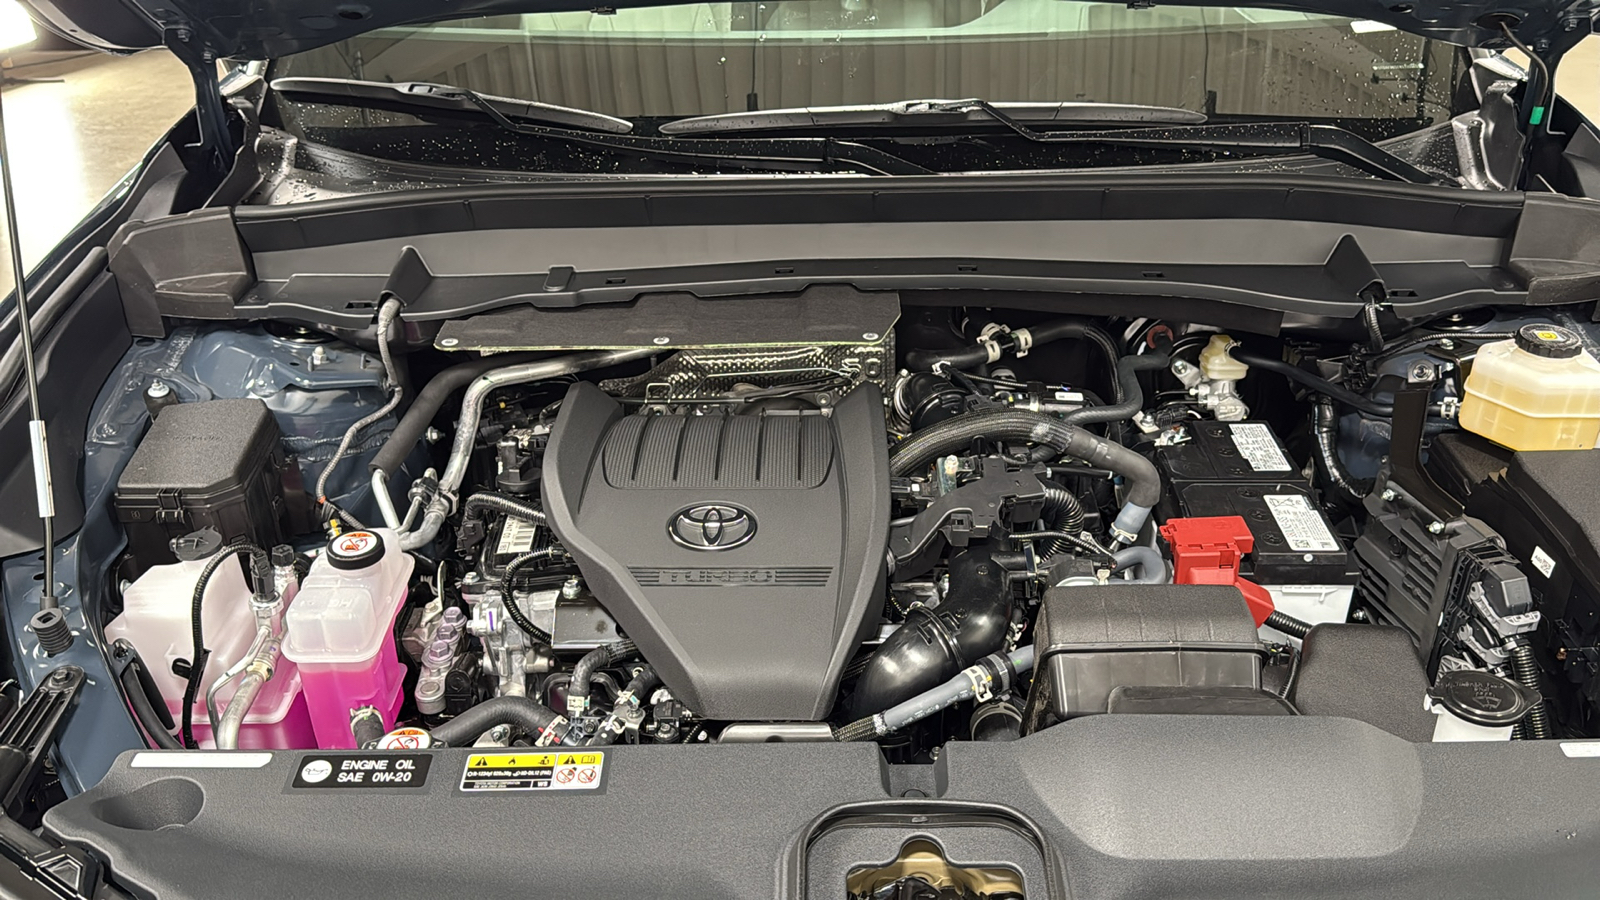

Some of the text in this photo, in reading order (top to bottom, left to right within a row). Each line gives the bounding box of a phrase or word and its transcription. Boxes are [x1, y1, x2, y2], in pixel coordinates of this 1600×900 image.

[662, 570, 773, 583] TURBO
[341, 759, 416, 770] ENGINE OIL
[336, 772, 412, 782] SAE 0W-20
